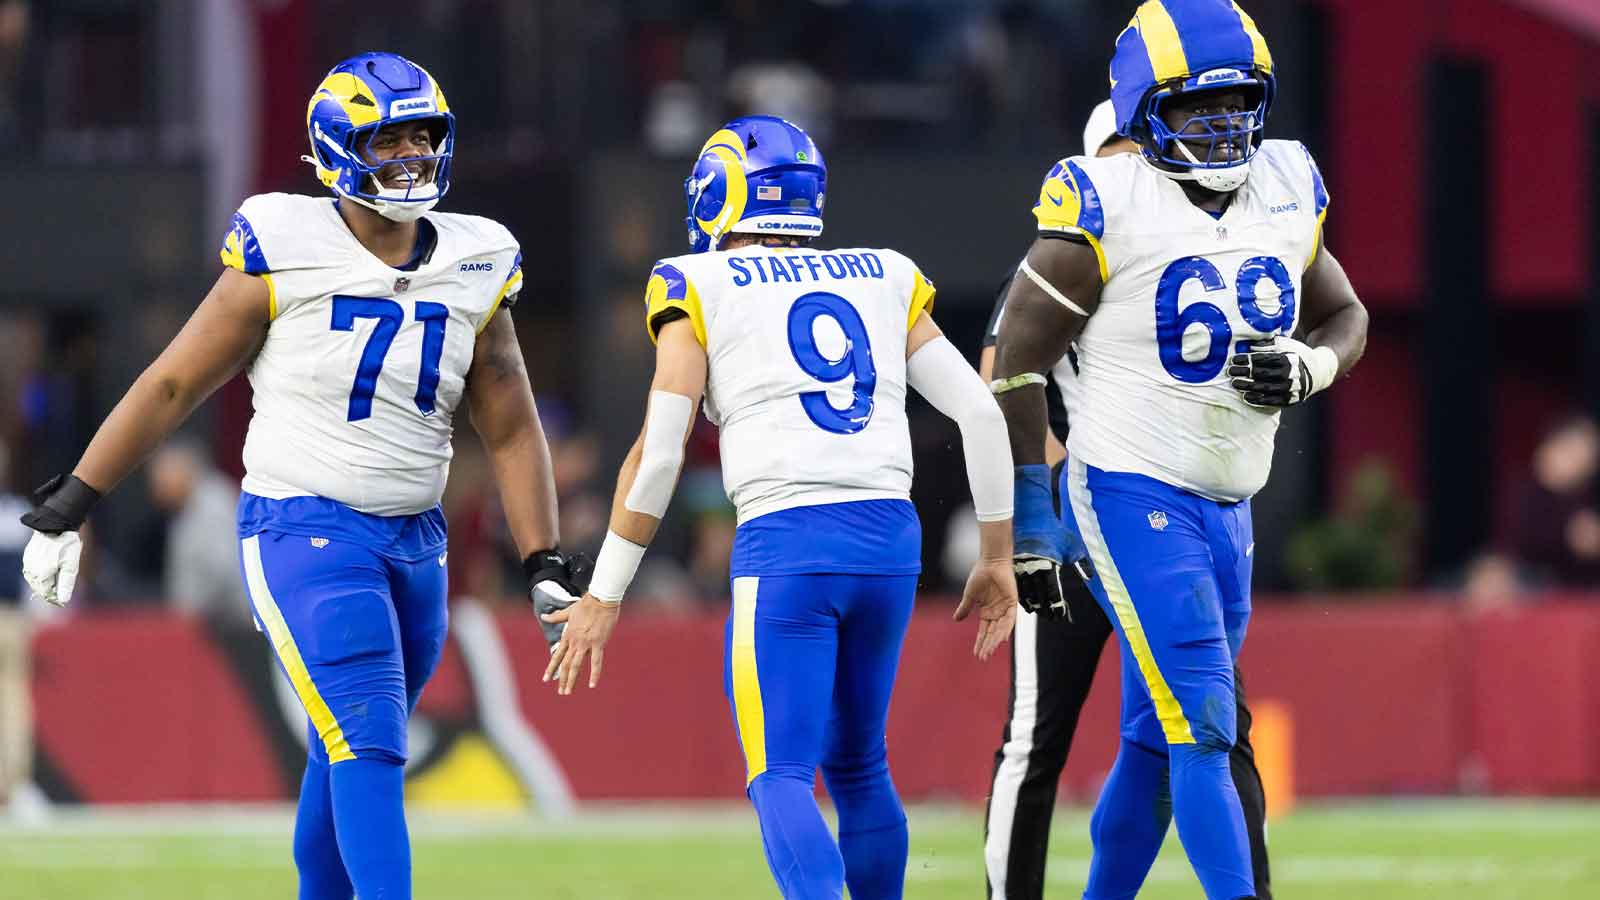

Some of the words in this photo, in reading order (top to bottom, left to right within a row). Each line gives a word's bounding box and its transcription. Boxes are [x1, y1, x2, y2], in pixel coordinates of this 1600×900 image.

[1269, 202, 1298, 214] RAMS
[460, 263, 493, 272] RAMS
[727, 253, 884, 287] STAFFORD
[330, 294, 450, 422] 71
[1155, 256, 1296, 384] 69
[787, 291, 877, 435] 9
